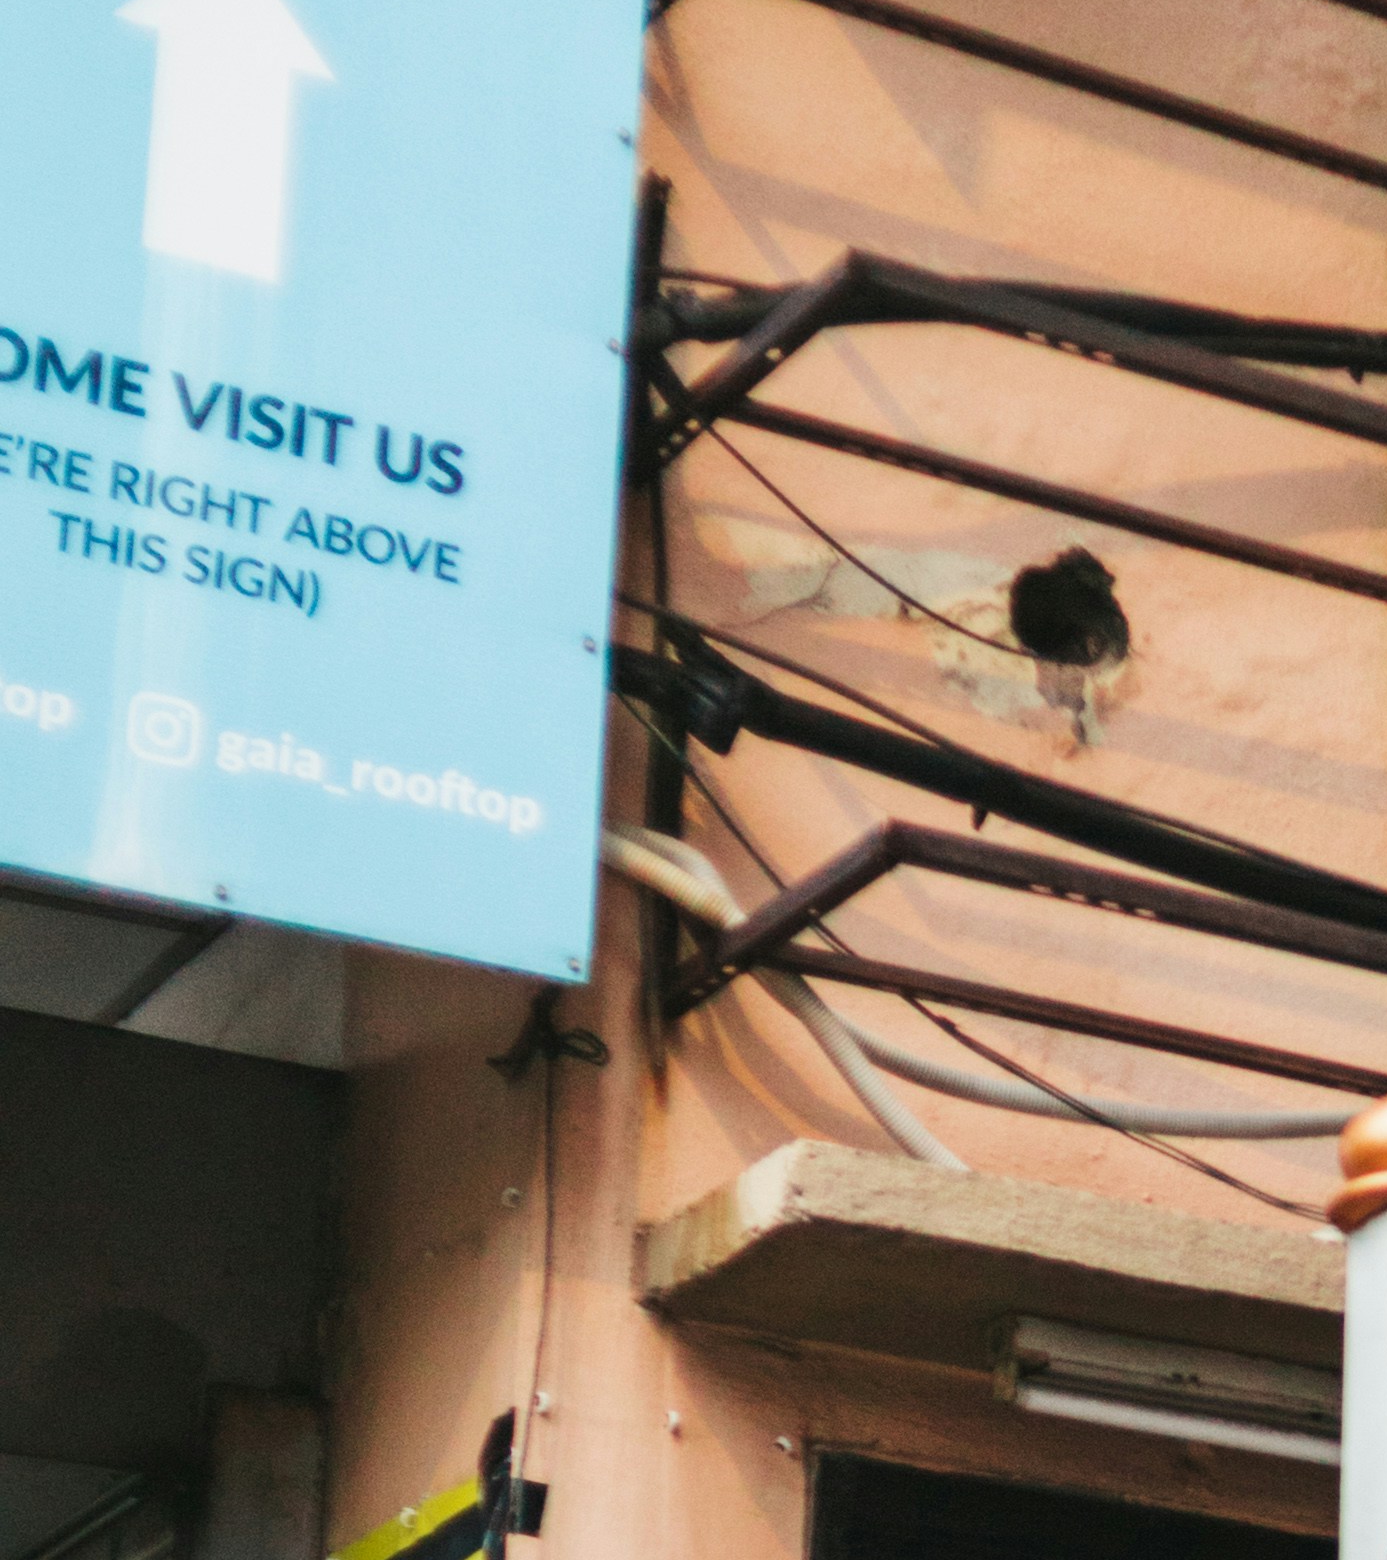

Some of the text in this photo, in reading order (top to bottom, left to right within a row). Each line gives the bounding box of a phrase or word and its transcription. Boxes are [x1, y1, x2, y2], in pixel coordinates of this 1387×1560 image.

[172, 371, 354, 466] VISIT
[375, 425, 466, 497] US
[50, 510, 322, 618] THIS SIGN)
[109, 461, 273, 536] RIGHT
[285, 505, 463, 586] ABOVE
[214, 729, 543, 834] gaia_rooftop
